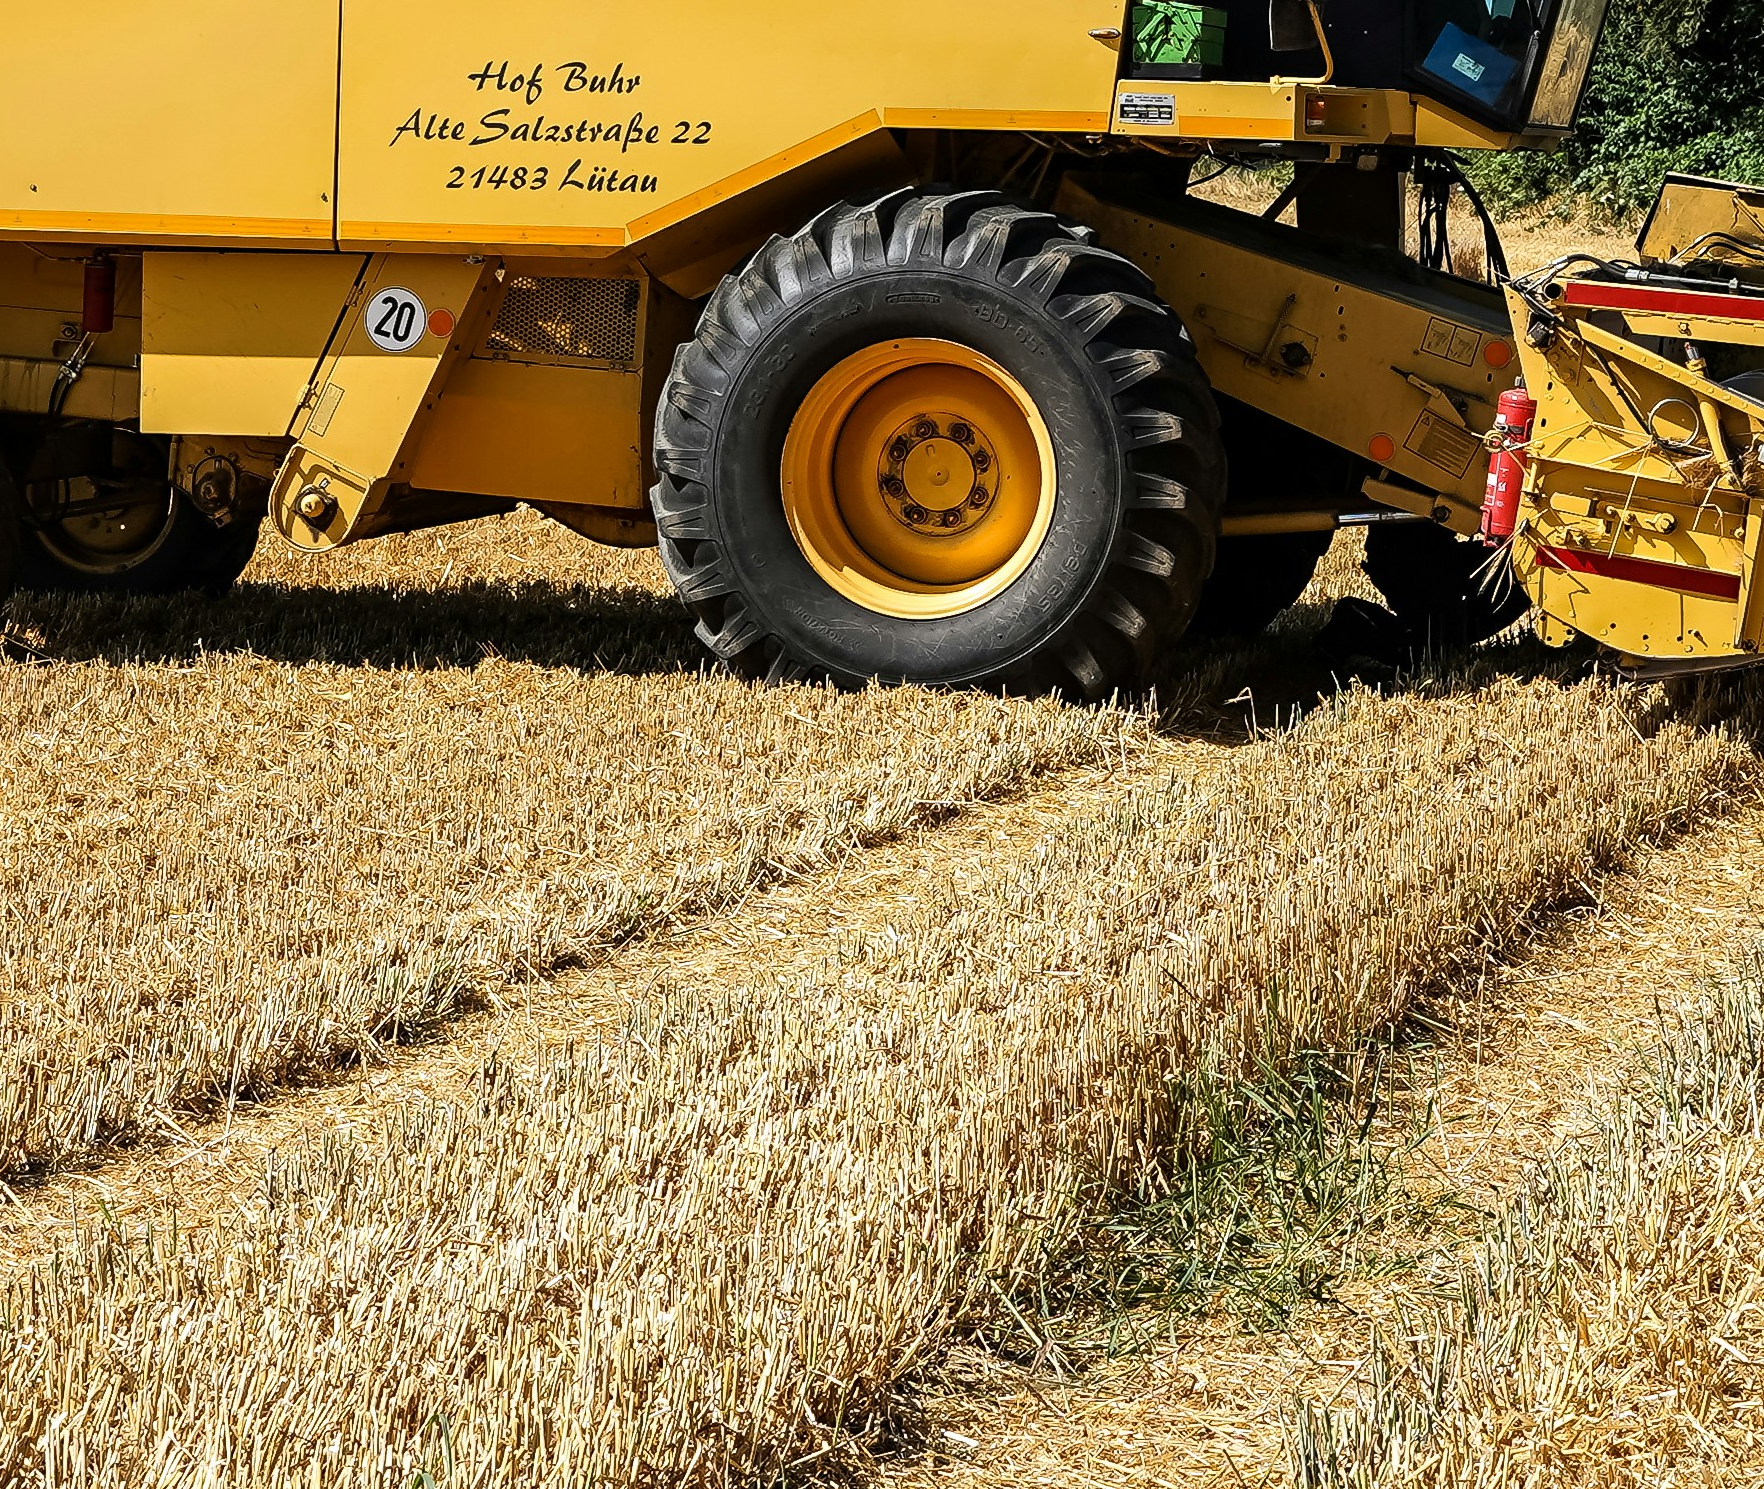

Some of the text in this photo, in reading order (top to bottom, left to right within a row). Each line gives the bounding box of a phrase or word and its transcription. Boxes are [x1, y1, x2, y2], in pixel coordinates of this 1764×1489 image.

[466, 60, 641, 106] Hof Buhr
[388, 107, 712, 154] Alte Salzstraße 22
[445, 158, 658, 194] 21483 Lütau
[374, 296, 416, 342] 20
